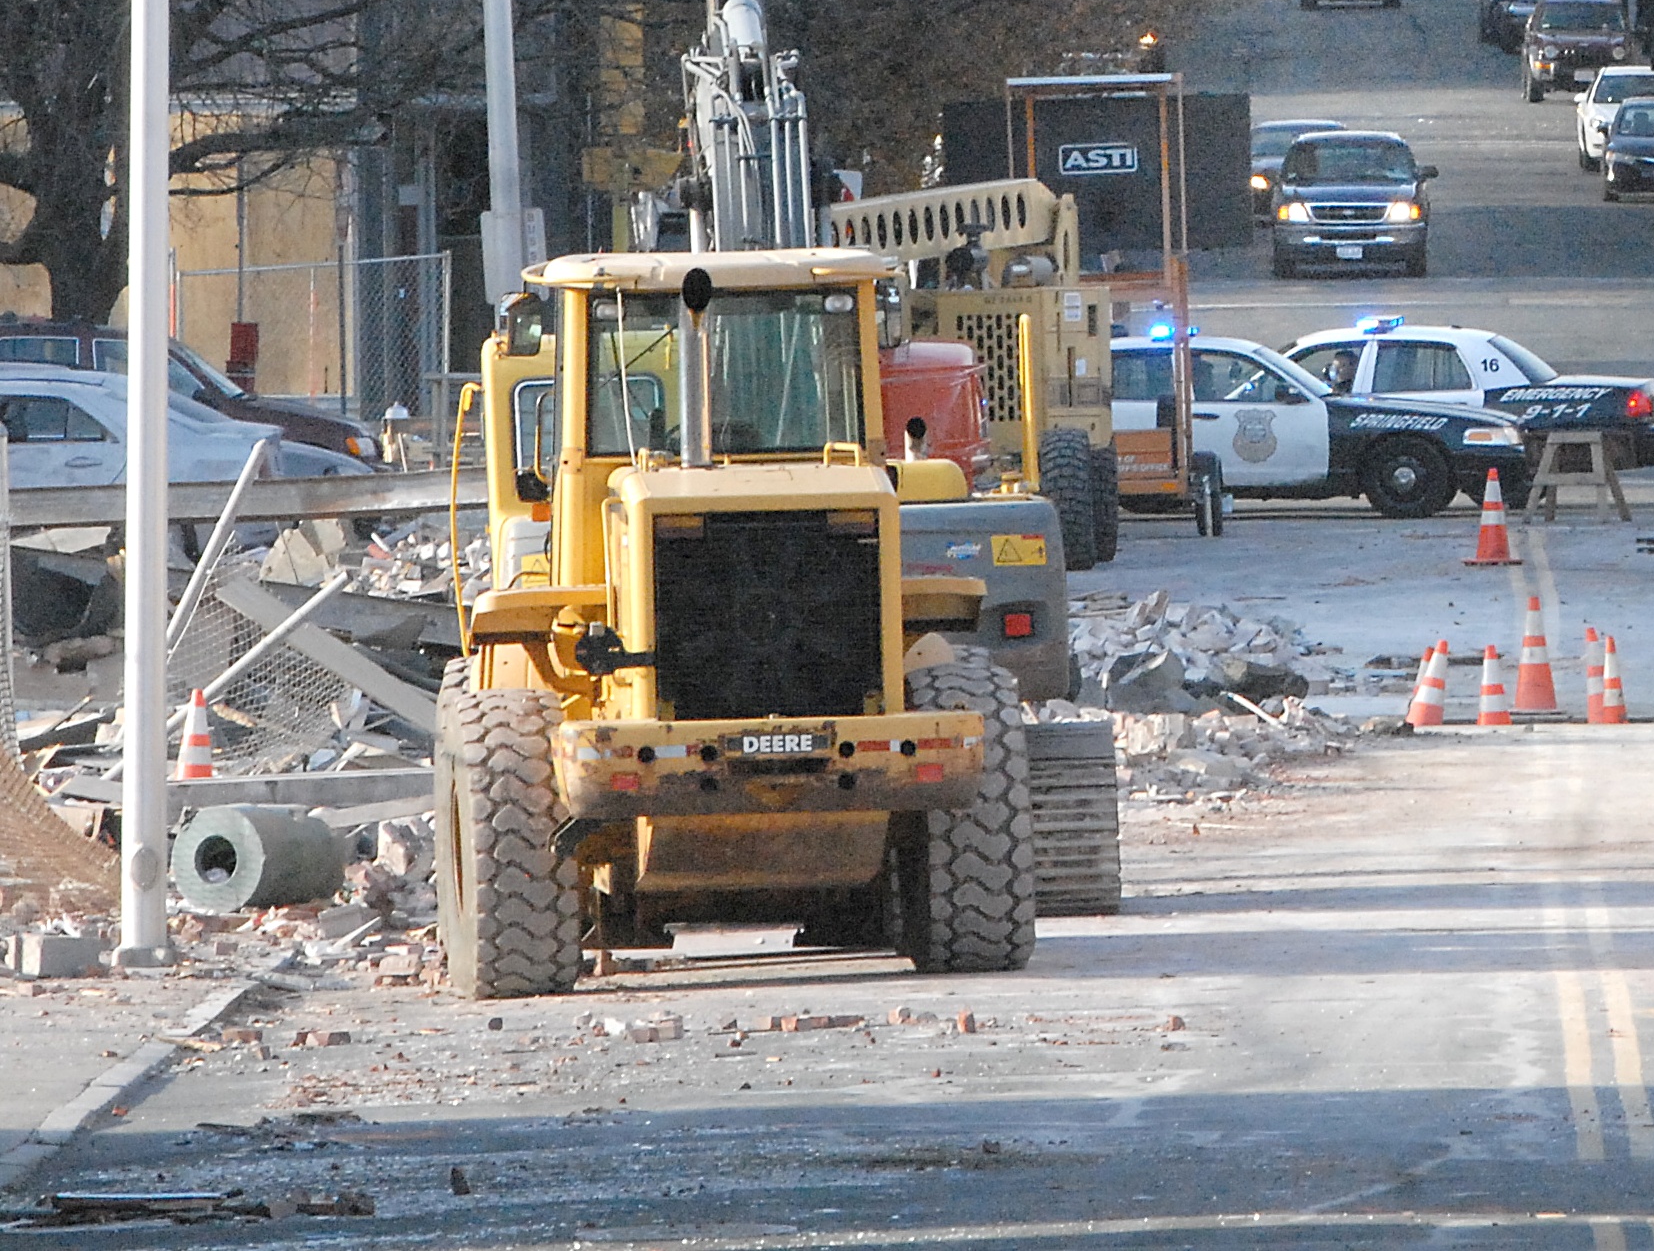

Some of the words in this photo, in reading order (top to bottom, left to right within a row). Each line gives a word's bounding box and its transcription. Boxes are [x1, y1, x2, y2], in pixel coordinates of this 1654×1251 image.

[1064, 149, 1133, 169] ASTI
[1480, 358, 1500, 372] 16
[1500, 388, 1614, 402] EMERGENCY
[1522, 403, 1592, 419] 9-1-1
[1350, 413, 1450, 430] SPRINGFIELD
[743, 734, 812, 753] DEERE
